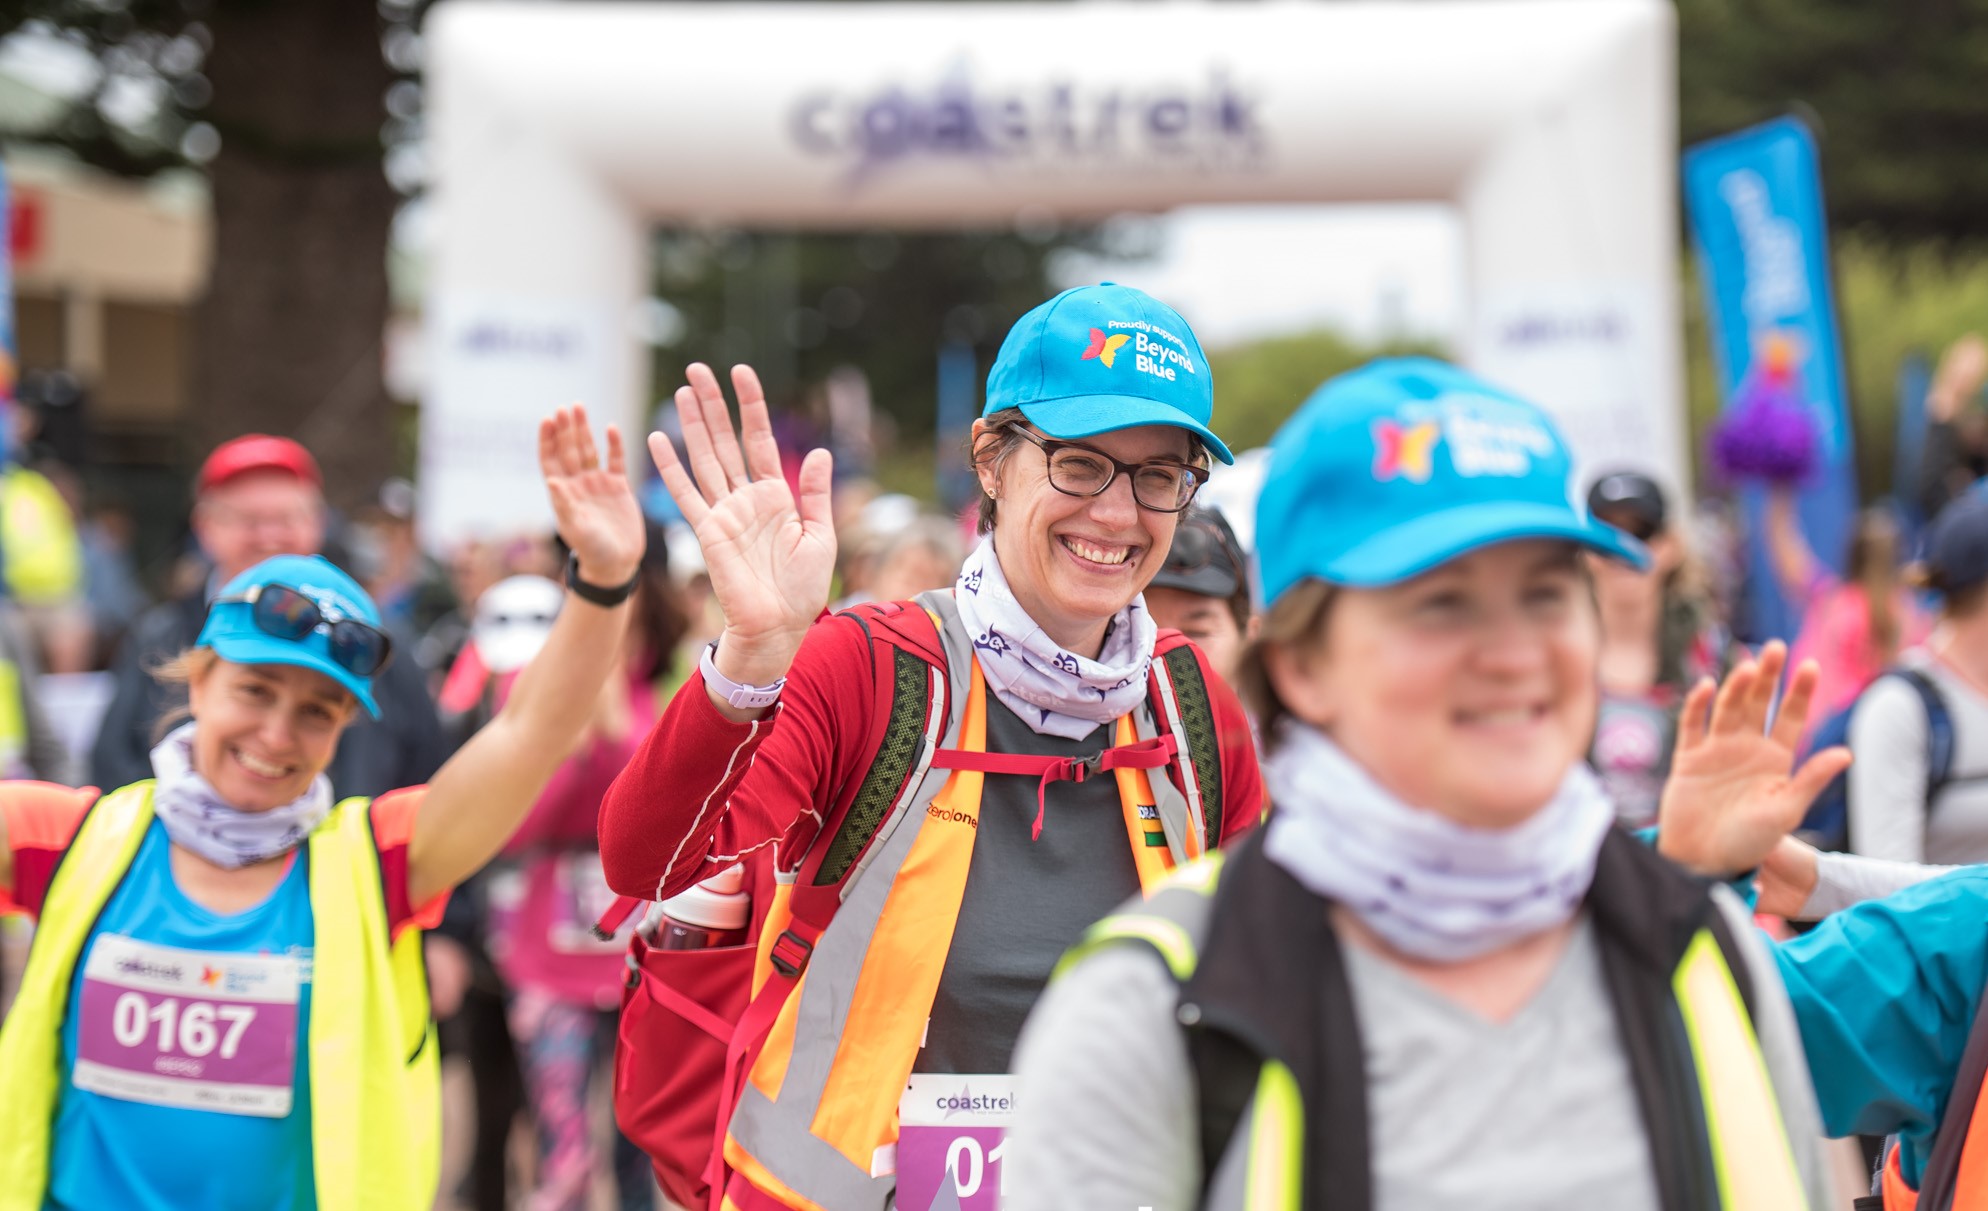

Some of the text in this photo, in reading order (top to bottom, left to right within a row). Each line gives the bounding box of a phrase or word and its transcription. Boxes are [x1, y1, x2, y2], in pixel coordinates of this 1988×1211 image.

[790, 64, 1264, 157] coastrek
[1108, 320, 1151, 332] Proudly
[1136, 332, 1195, 374] Beyond
[1136, 353, 1176, 381] Blue
[112, 991, 257, 1060] 0167
